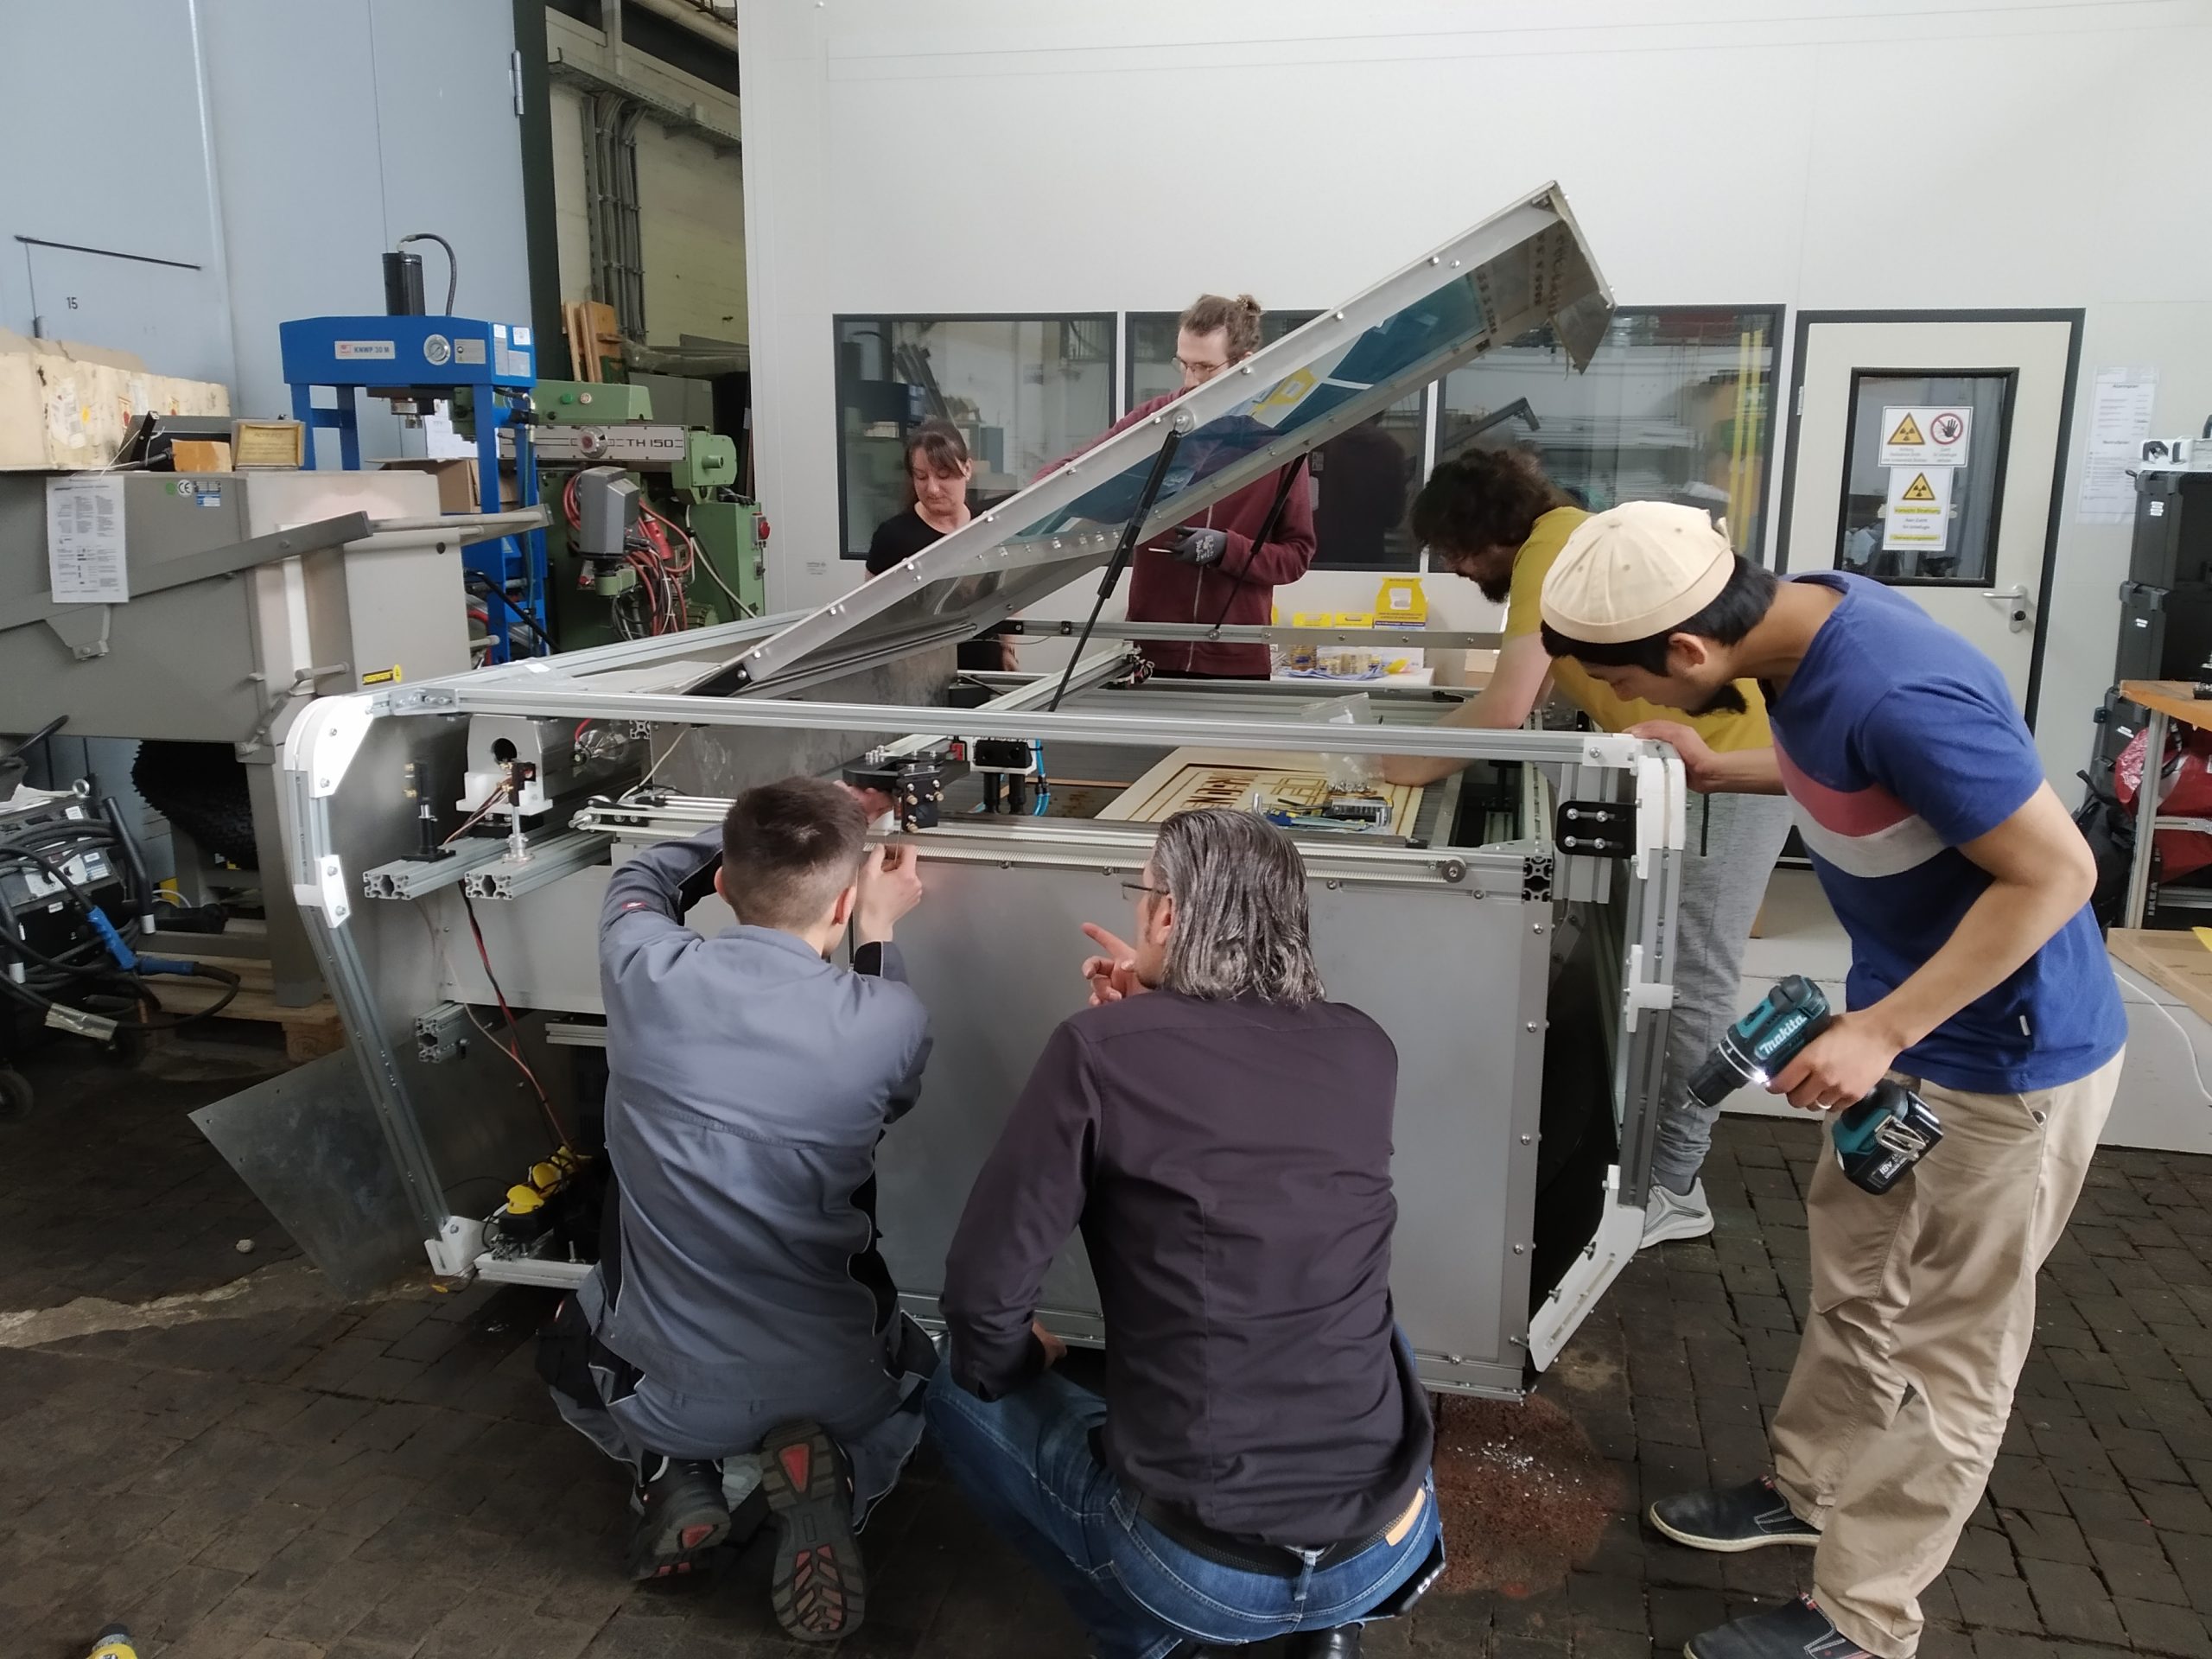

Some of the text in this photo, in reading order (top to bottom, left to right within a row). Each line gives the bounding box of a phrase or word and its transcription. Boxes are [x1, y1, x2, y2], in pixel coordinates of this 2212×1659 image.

[67, 296, 79, 310] 15
[626, 439, 674, 448] TH 150
